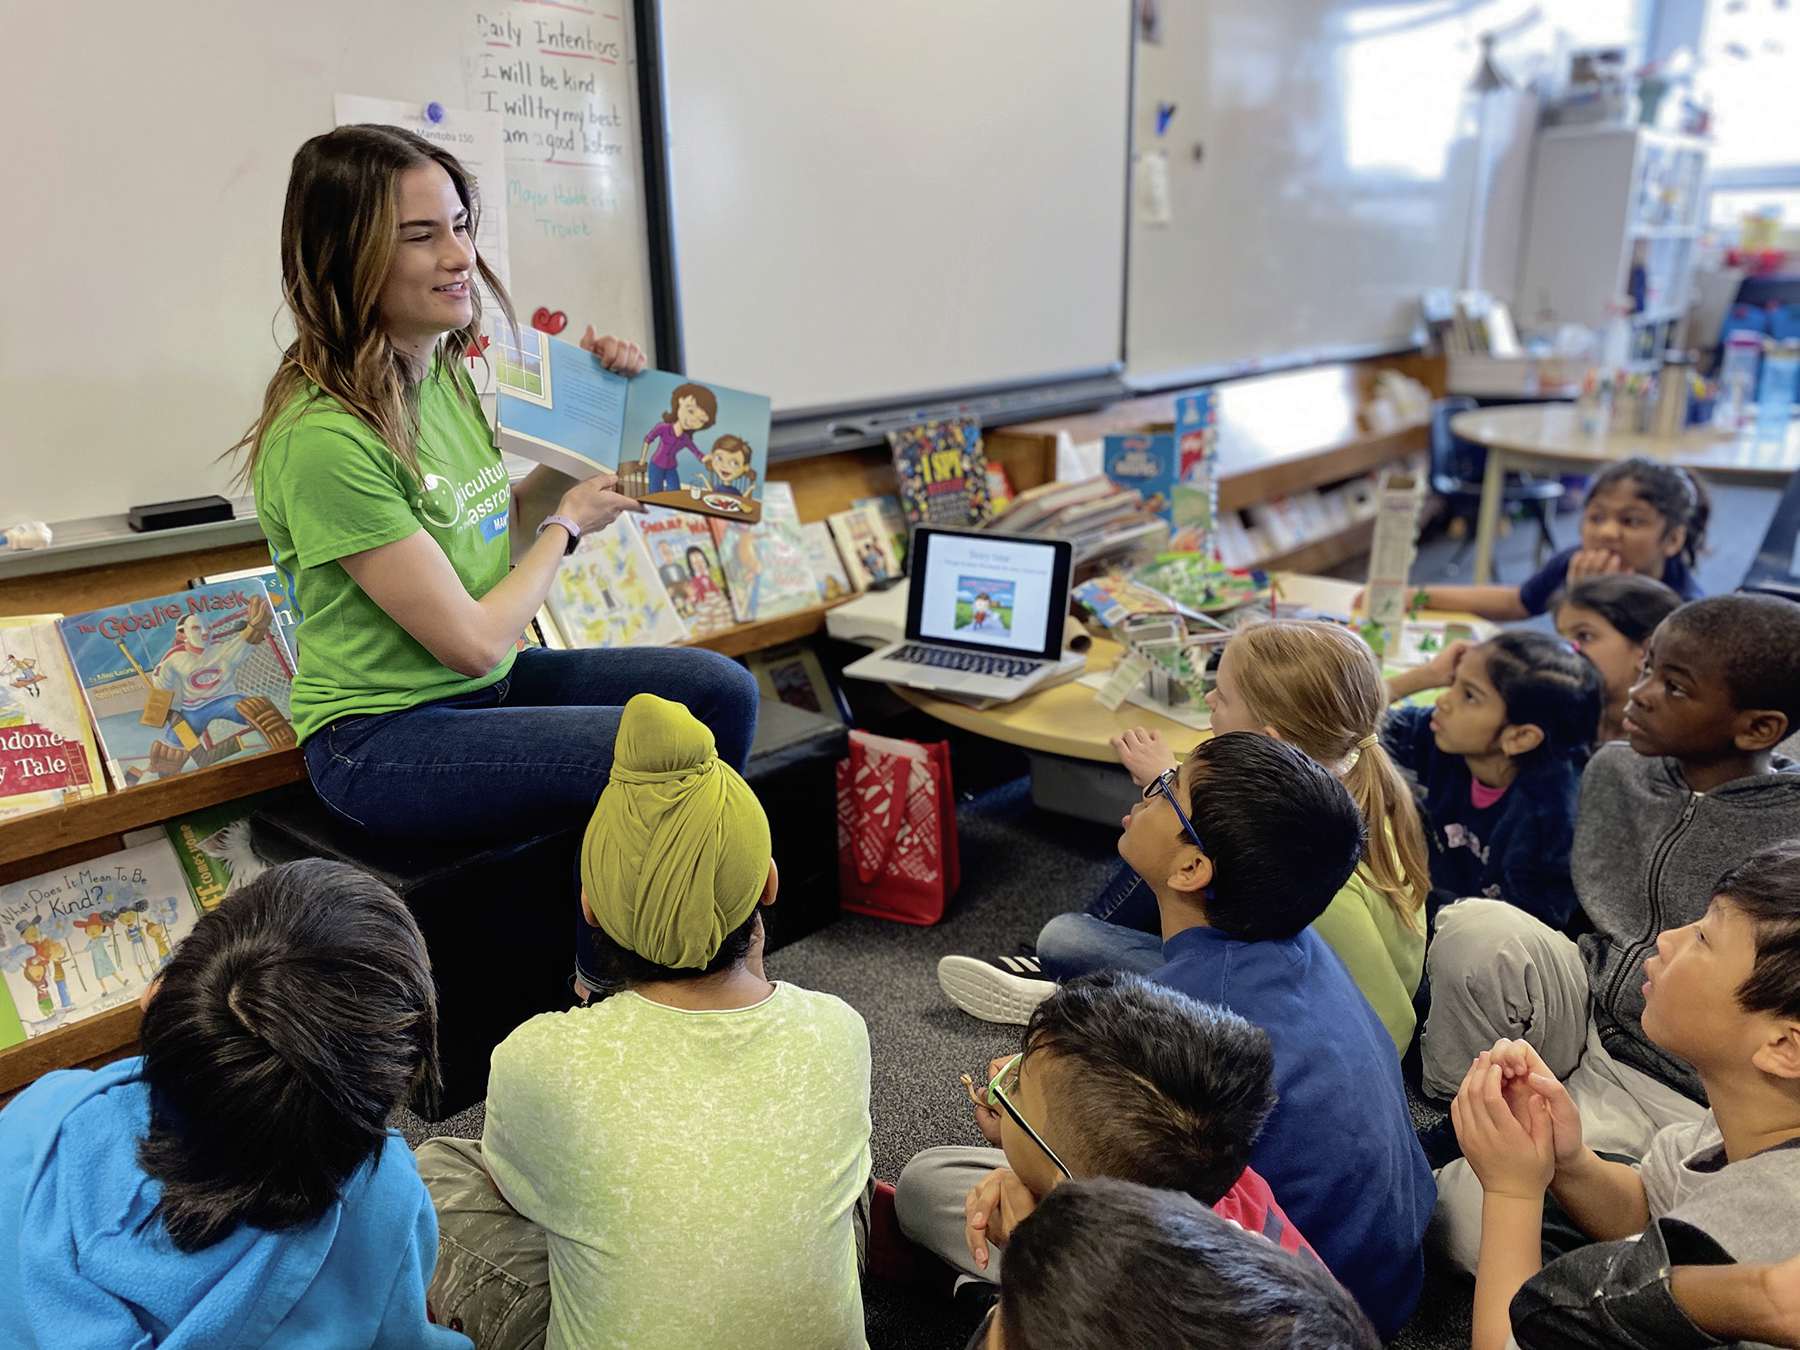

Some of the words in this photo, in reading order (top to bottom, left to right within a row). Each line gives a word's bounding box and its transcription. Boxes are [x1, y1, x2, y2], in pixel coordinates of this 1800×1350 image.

[499, 60, 532, 86] will
[540, 65, 558, 90] be
[563, 66, 595, 94] kind
[480, 91, 498, 112] I
[503, 129, 528, 143] am
[545, 128, 574, 161] good
[98, 603, 183, 640] Goalie
[185, 590, 250, 616] Mask
[14, 755, 68, 779] Tale
[0, 901, 31, 926] What
[28, 888, 62, 904] Does
[63, 875, 78, 889] It
[79, 869, 112, 885] Mean
[114, 866, 128, 881] To
[131, 867, 148, 885] Be
[48, 885, 105, 918] Kind?
